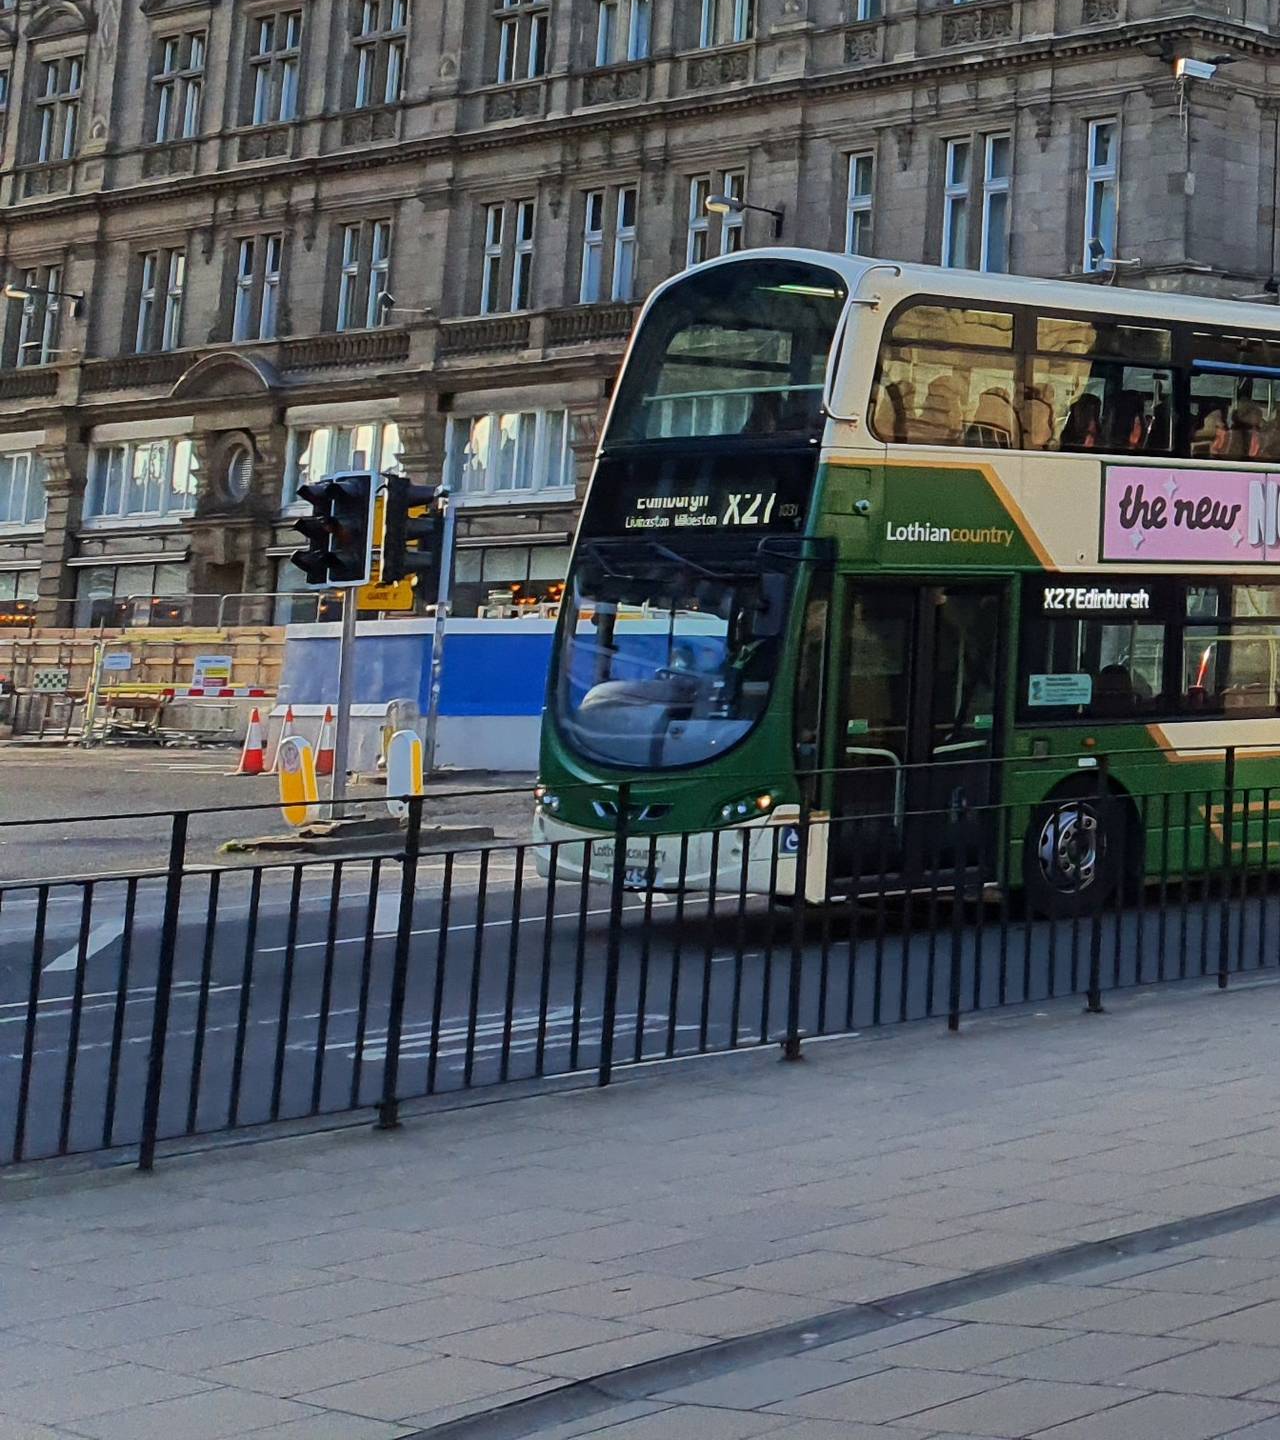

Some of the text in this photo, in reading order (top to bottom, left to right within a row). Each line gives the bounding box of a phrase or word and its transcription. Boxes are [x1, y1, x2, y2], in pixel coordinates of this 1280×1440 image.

[1119, 484, 1167, 529] the
[1173, 496, 1241, 531] new
[1044, 588, 1150, 609] X27 Edinburgh
